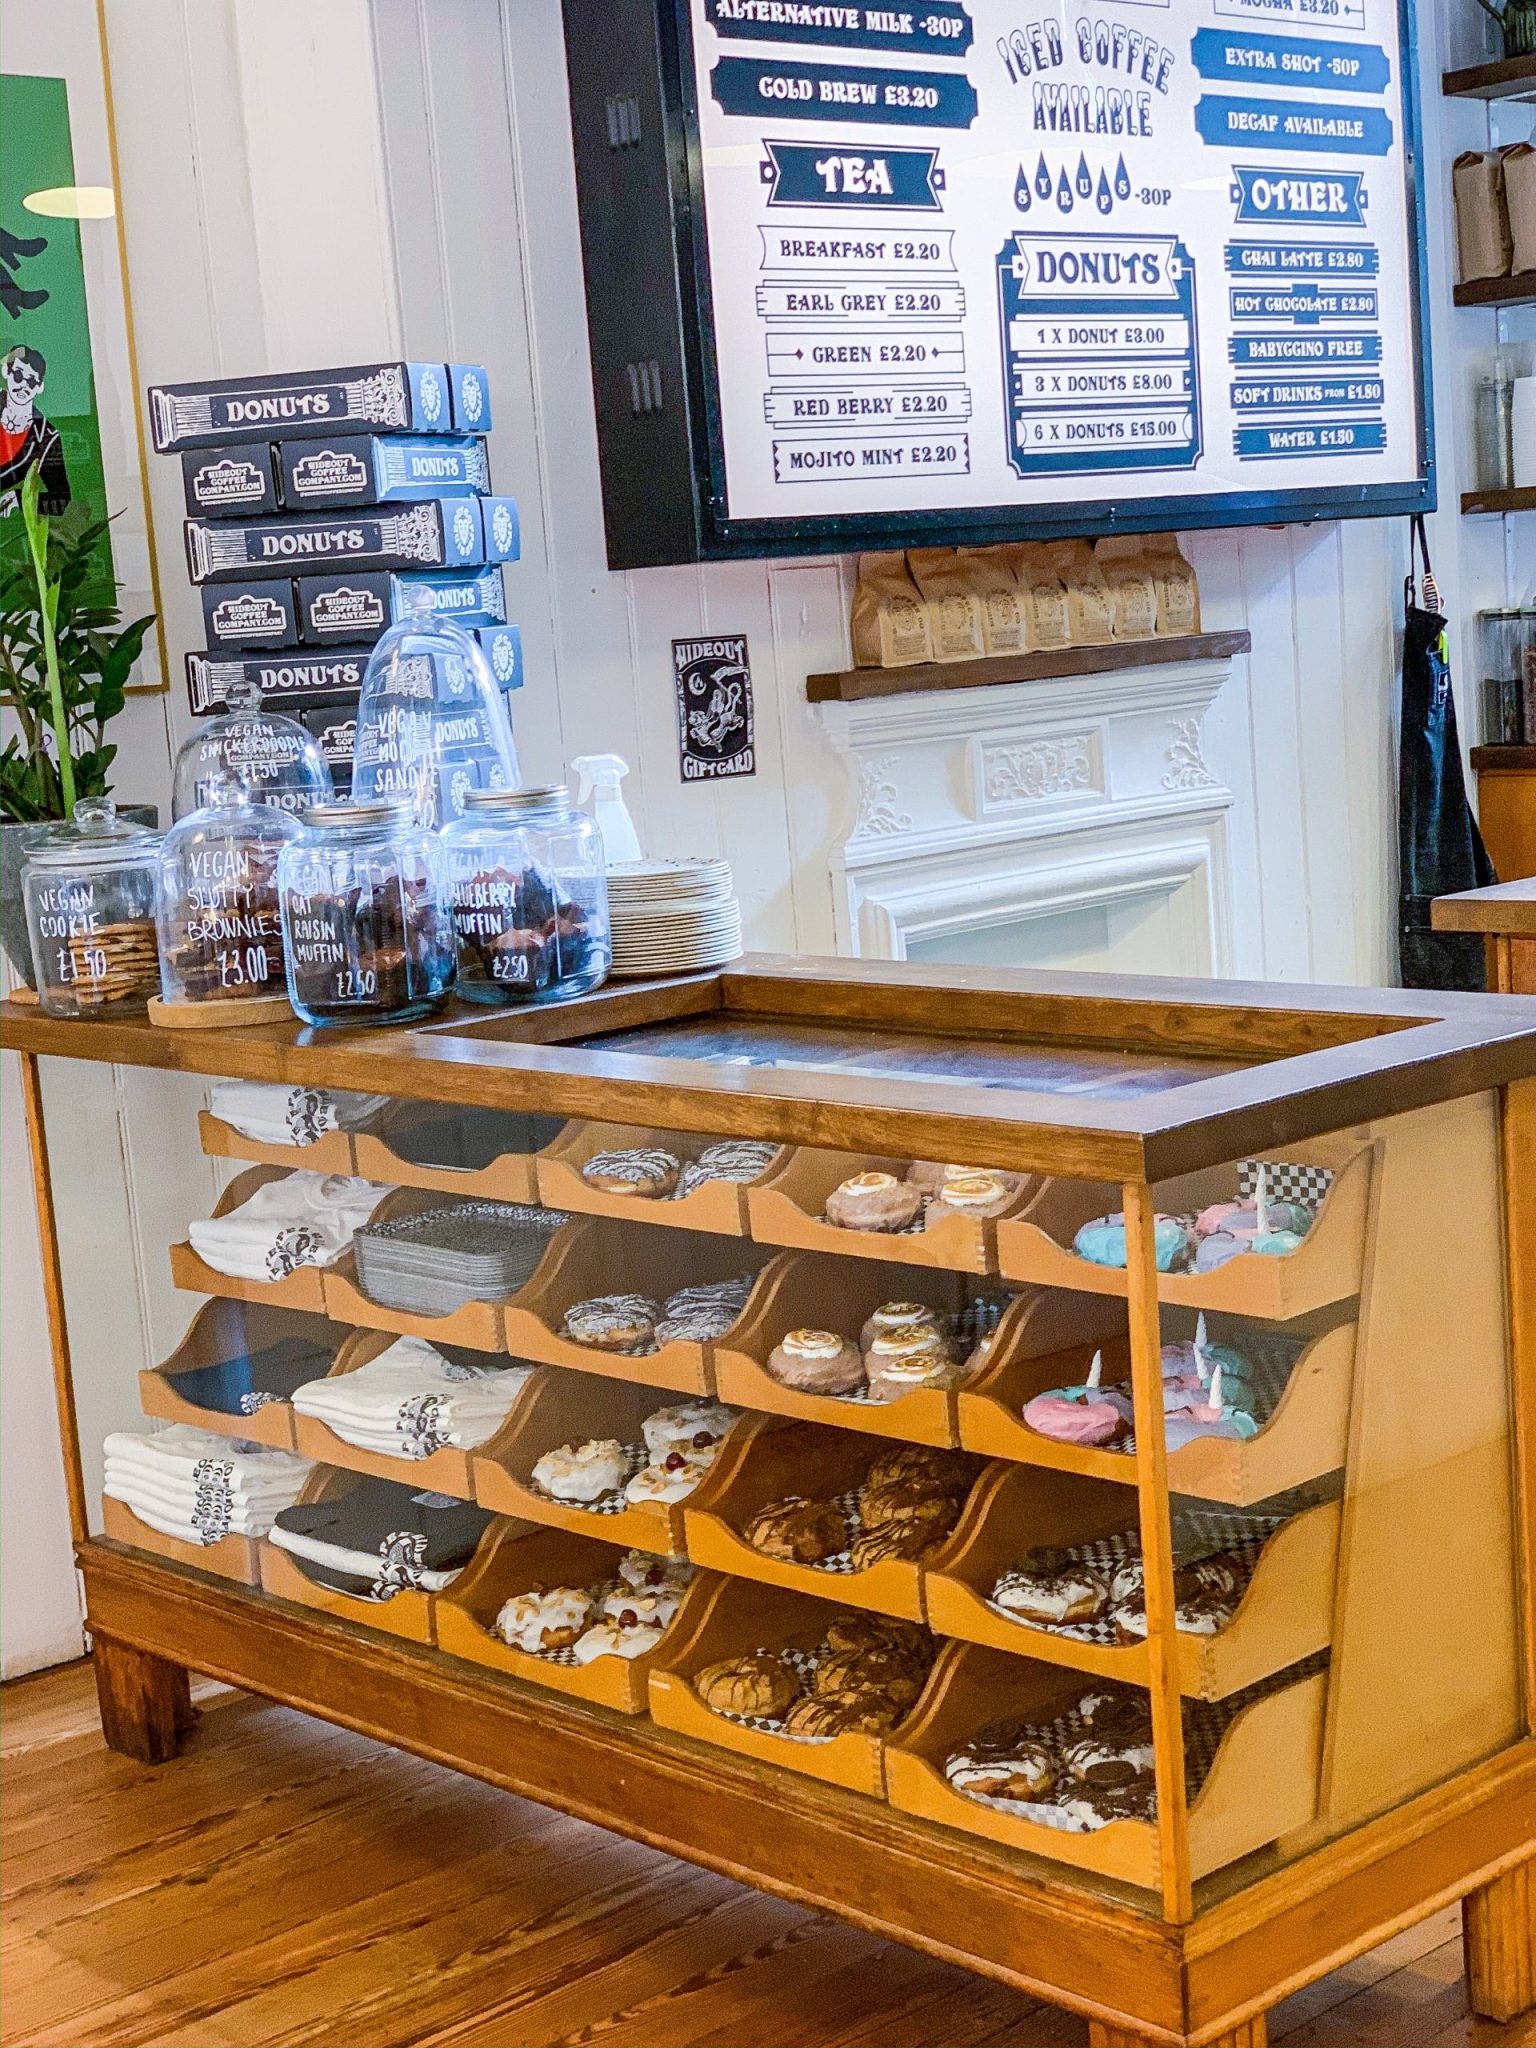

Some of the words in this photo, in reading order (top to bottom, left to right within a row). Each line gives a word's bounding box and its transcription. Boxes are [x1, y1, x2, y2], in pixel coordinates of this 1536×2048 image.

[715, 0, 860, 29] ALTERNATIVE
[865, 11, 913, 34] MILK
[996, 18, 1064, 84] ICED
[1075, 16, 1175, 95] COFFEE
[1225, 47, 1277, 69] EXTRA
[1281, 53, 1322, 73] SHOT
[758, 75, 813, 100] COLD
[819, 83, 878, 105] BREW
[884, 86, 939, 108] £3.20
[1032, 81, 1153, 137] AVAILABLE
[1227, 111, 1279, 132] DECAF
[1284, 116, 1364, 138] AVAILABLE
[815, 156, 894, 195] TEA
[1251, 178, 1348, 213] OTHER
[780, 239, 886, 258] BREAKFAST
[893, 242, 940, 260] £2.20
[1241, 250, 1276, 266] CHAI
[1281, 252, 1324, 267] LATTE
[1328, 251, 1365, 267] £2.80
[1035, 250, 1161, 284] DONUTS
[786, 294, 835, 311] EARL
[841, 294, 887, 311] GREY
[894, 293, 941, 311] £2.20
[1235, 296, 1262, 312] HOT
[1265, 296, 1337, 312] CHOCOLATE
[1341, 296, 1374, 312] £2.80
[1036, 328, 1046, 344] 1
[1052, 328, 1063, 344] X
[1068, 327, 1119, 344] DONUT
[1124, 327, 1166, 344] £3.00
[812, 346, 872, 363] GREEN
[879, 345, 927, 362] £2.20
[1248, 341, 1324, 357] BABYCCINO
[1328, 340, 1364, 356] FREE
[1034, 376, 1045, 391] 3
[1051, 376, 1063, 392] X
[1067, 375, 1128, 391] DONUTS
[1132, 374, 1173, 390] £8.00
[1233, 387, 1271, 404] SOFT
[1273, 385, 1323, 402] DRINKS
[1324, 389, 1345, 399] FROM
[1348, 383, 1382, 399] £1.80
[226, 393, 331, 422] DONUTS
[794, 399, 830, 416] RED
[837, 397, 895, 415] BERRY
[902, 395, 948, 413] £2.20
[1033, 424, 1044, 440] 6
[1050, 424, 1060, 440] X
[1065, 423, 1125, 440] DONUTS
[1130, 420, 1177, 437] £15.00
[1268, 431, 1316, 448] WATER
[309, 457, 349, 470] HIDEOUT
[411, 456, 459, 477] DONUTS
[790, 450, 855, 469] MOJITO
[861, 447, 904, 465] MINT
[911, 446, 957, 464] £2.20
[208, 467, 248, 479] HIDEOUT
[210, 476, 247, 487] COFFEE
[298, 473, 362, 487] COMPANY.COM
[310, 467, 348, 478] COFFEE
[199, 482, 261, 496] COMPANY.COM
[261, 529, 365, 556] DONUTS
[228, 603, 269, 614] HIDEOUT
[325, 595, 367, 606] HIDEOUT
[327, 603, 365, 614] COFFEE
[218, 618, 282, 630] COMPANY.COM
[230, 611, 268, 621] COFFEE
[315, 610, 380, 623] COMPANY.COM
[674, 640, 745, 671] HIDEOUT
[259, 662, 360, 689] DONUTS
[225, 723, 274, 738] VEGAN
[436, 717, 480, 743] DONUTS
[190, 850, 250, 879] VEGAN
[39, 884, 94, 912] VEGAN
[187, 881, 254, 911] SLUTTY
[292, 894, 312, 915] OAT
[40, 911, 106, 938] COOKIE
[187, 914, 283, 942] BROWNIES
[294, 918, 336, 941] RAISIN
[455, 912, 503, 936] MUFFIN
[296, 943, 345, 963] MUFFIN
[56, 946, 107, 982] £1.50
[217, 944, 269, 988] £3.00
[492, 954, 529, 979] £2.50
[336, 969, 377, 998] £2.50
